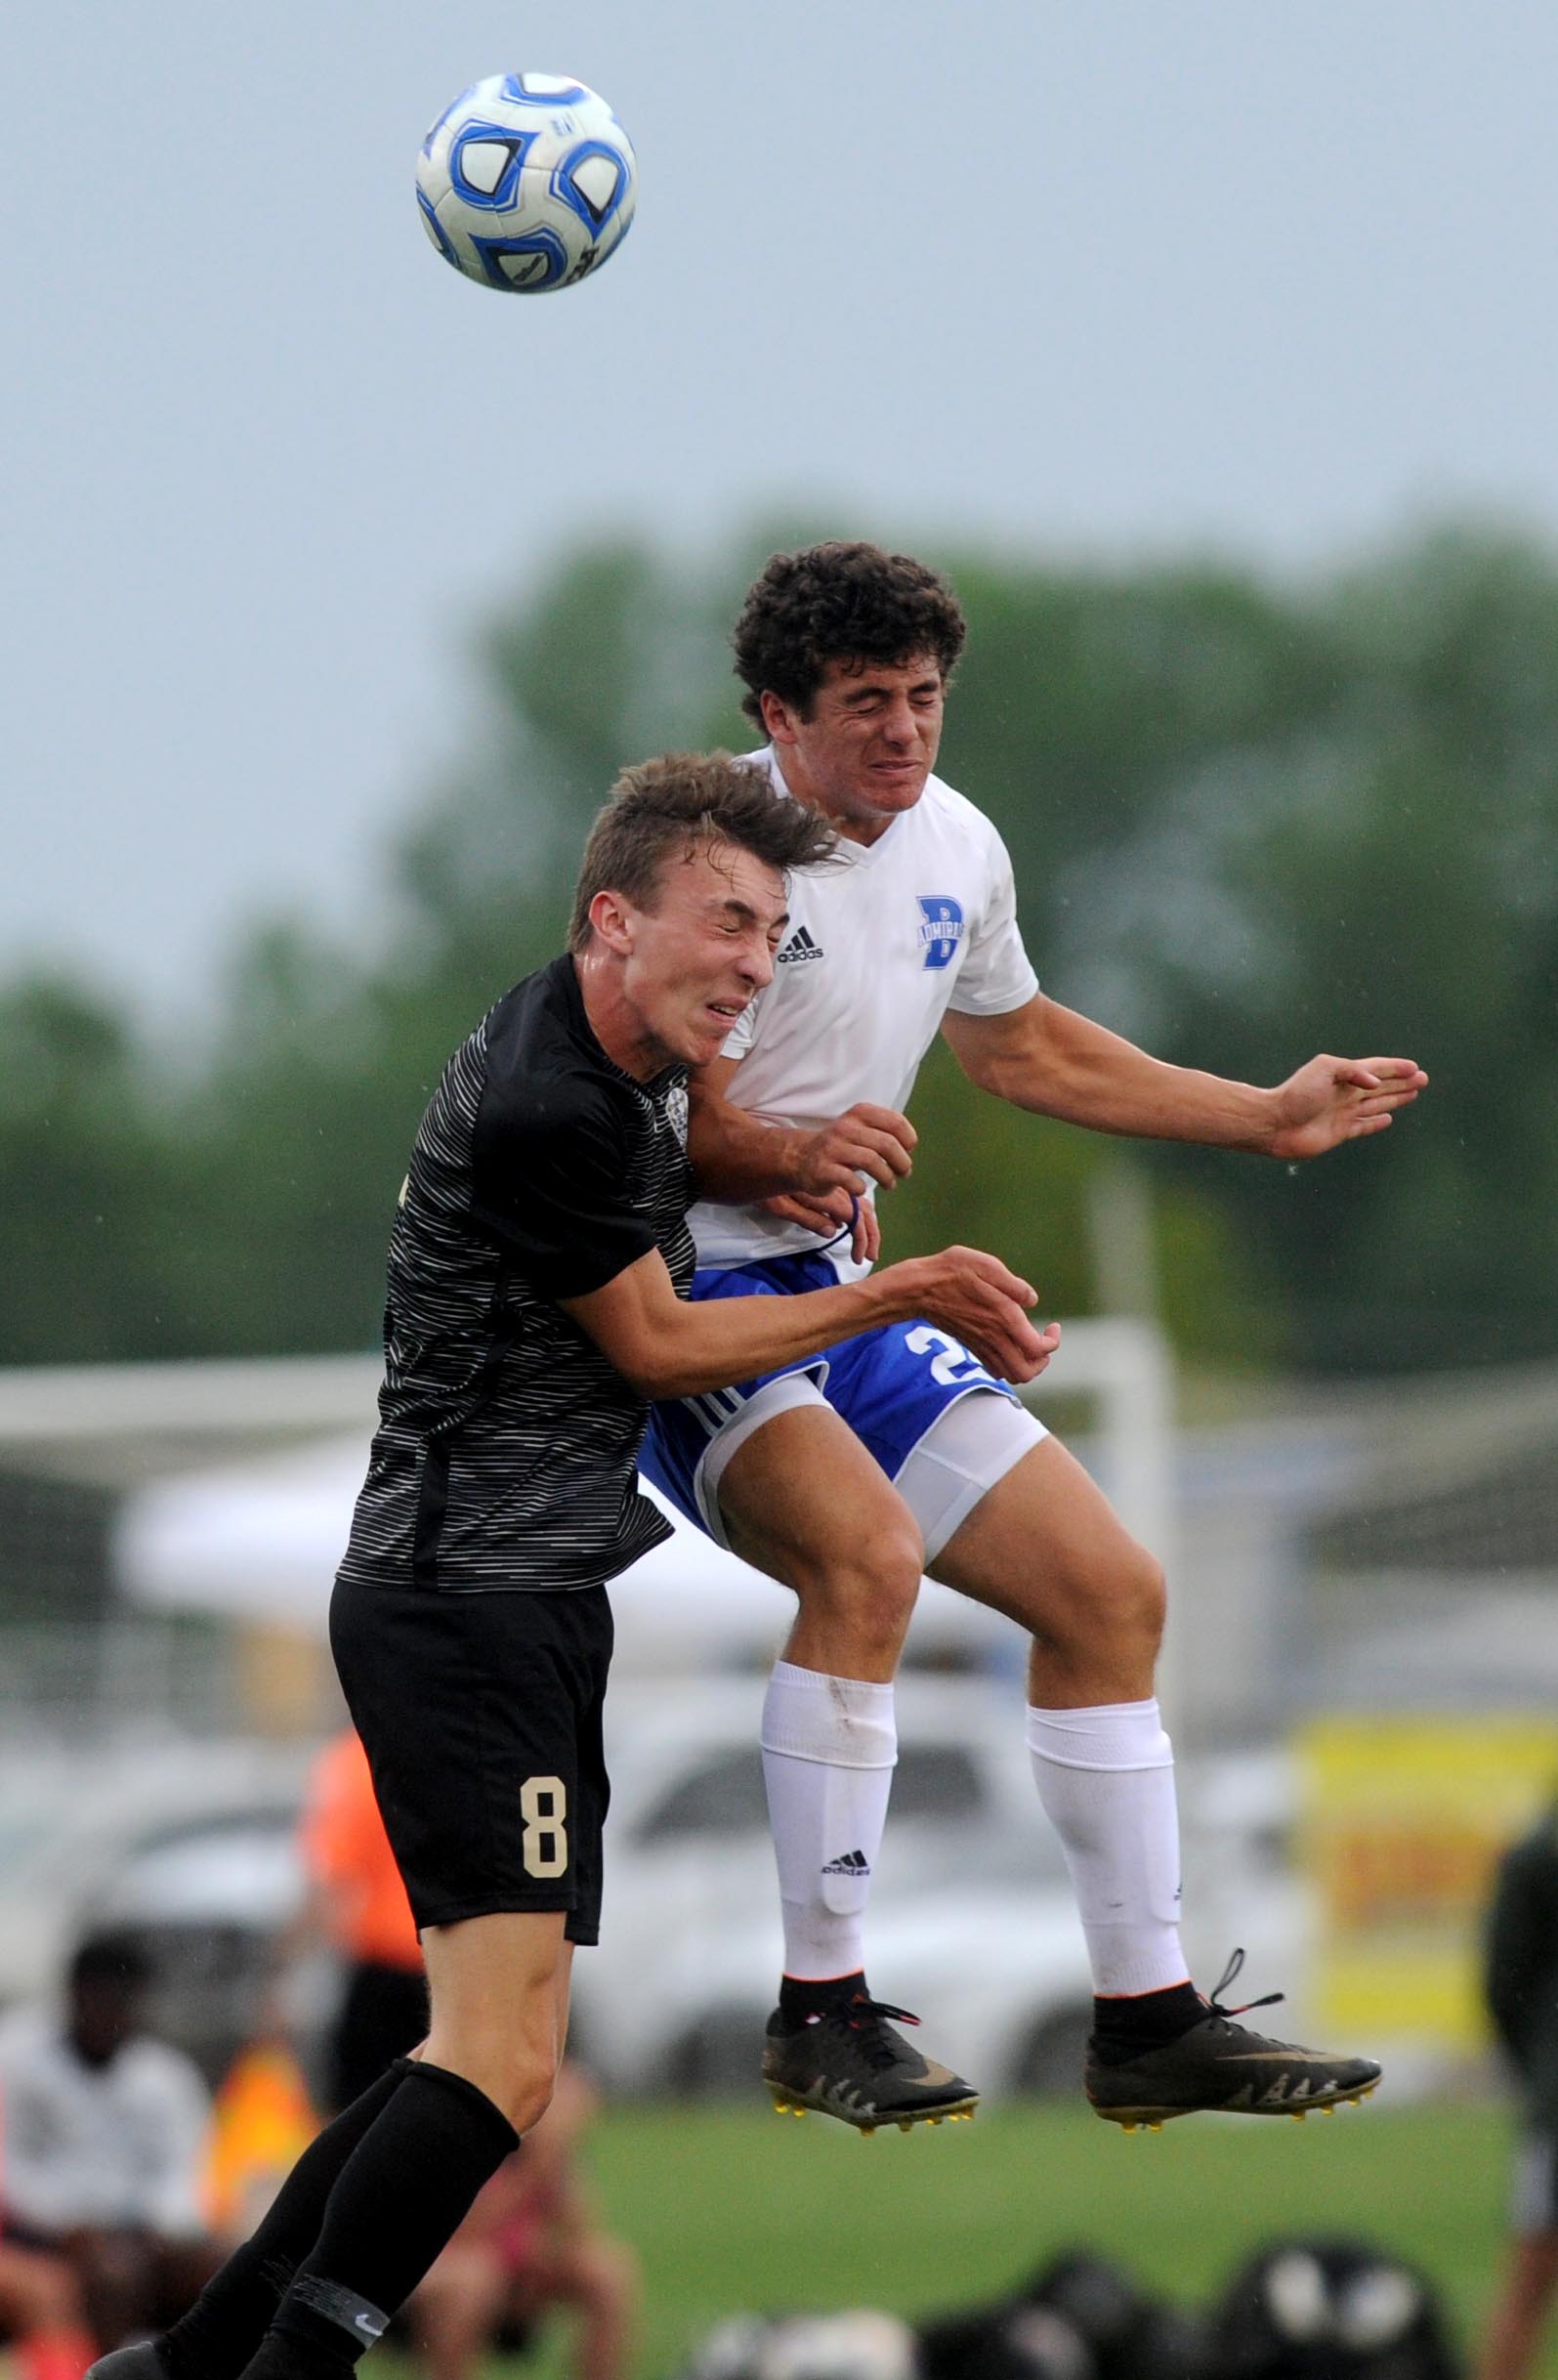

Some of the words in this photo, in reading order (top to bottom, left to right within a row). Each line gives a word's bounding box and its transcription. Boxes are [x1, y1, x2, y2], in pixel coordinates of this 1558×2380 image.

[778, 948, 823, 963] adidas
[905, 1326, 996, 1385] 2
[520, 1776, 568, 1878] 8
[821, 1865, 870, 1877] adidas
